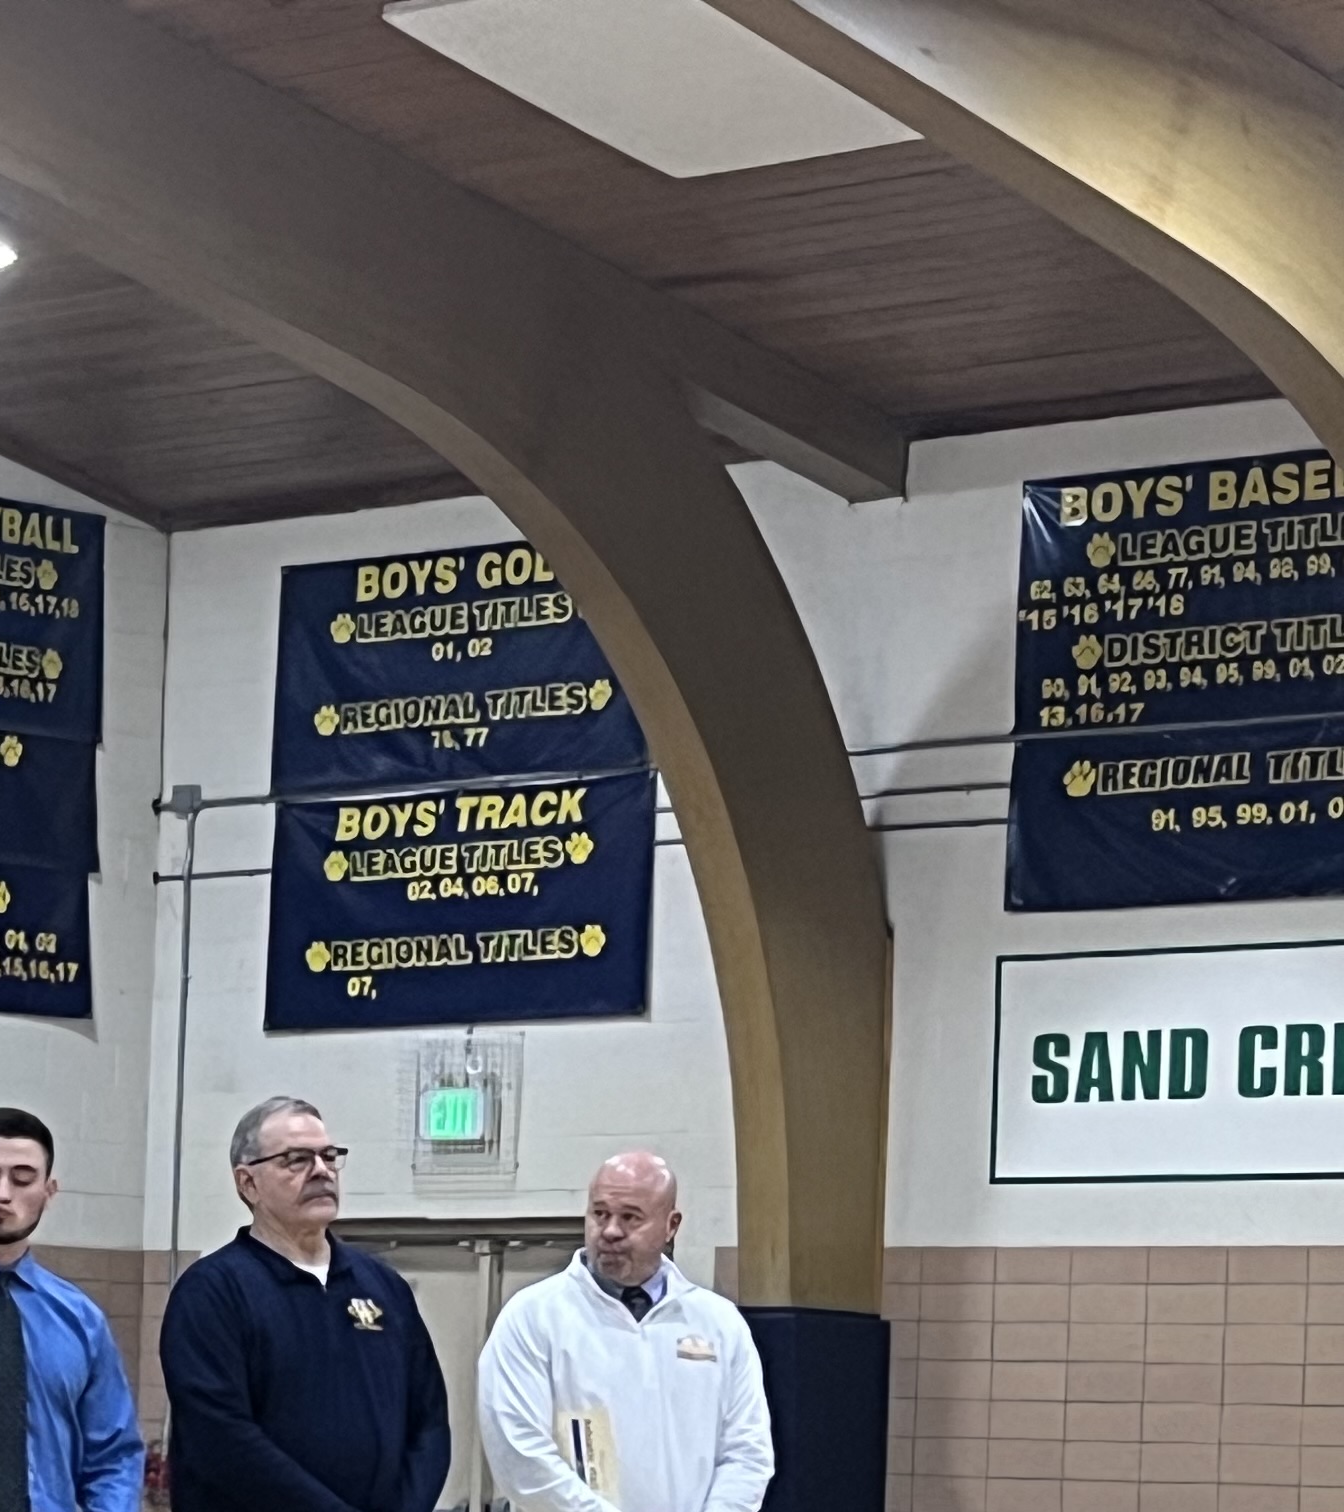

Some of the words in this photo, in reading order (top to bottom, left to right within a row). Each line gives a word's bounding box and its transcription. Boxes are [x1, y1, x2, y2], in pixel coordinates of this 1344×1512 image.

[1060, 474, 1193, 527] BOYS'
[1117, 520, 1257, 567] LEAGUE
[1262, 513, 1344, 553] TITL
[356, 557, 465, 602] BOYS'
[476, 548, 555, 589] GOL
[355, 602, 469, 644] LEAGUE
[473, 592, 573, 631] TITLES
[1103, 621, 1267, 668] DISTRICT
[1270, 614, 1344, 653] TITL
[431, 642, 462, 662] 01,
[467, 637, 493, 658] 02
[340, 692, 481, 734] REGIONAL
[484, 682, 587, 720] TITLES
[463, 727, 489, 747] 77
[1097, 752, 1251, 796] REGIONAL
[1266, 747, 1344, 784] TITL
[335, 799, 445, 841] BOYS'
[455, 787, 587, 831] TRACK
[1192, 805, 1228, 829] 95,
[1279, 800, 1316, 824] 01,
[349, 844, 457, 881] LEAGUE
[461, 836, 564, 873] TITLES
[331, 934, 472, 971] REGIONAL
[476, 926, 578, 963] TITLES
[347, 977, 376, 999] 07,
[1031, 1028, 1209, 1104] SAND
